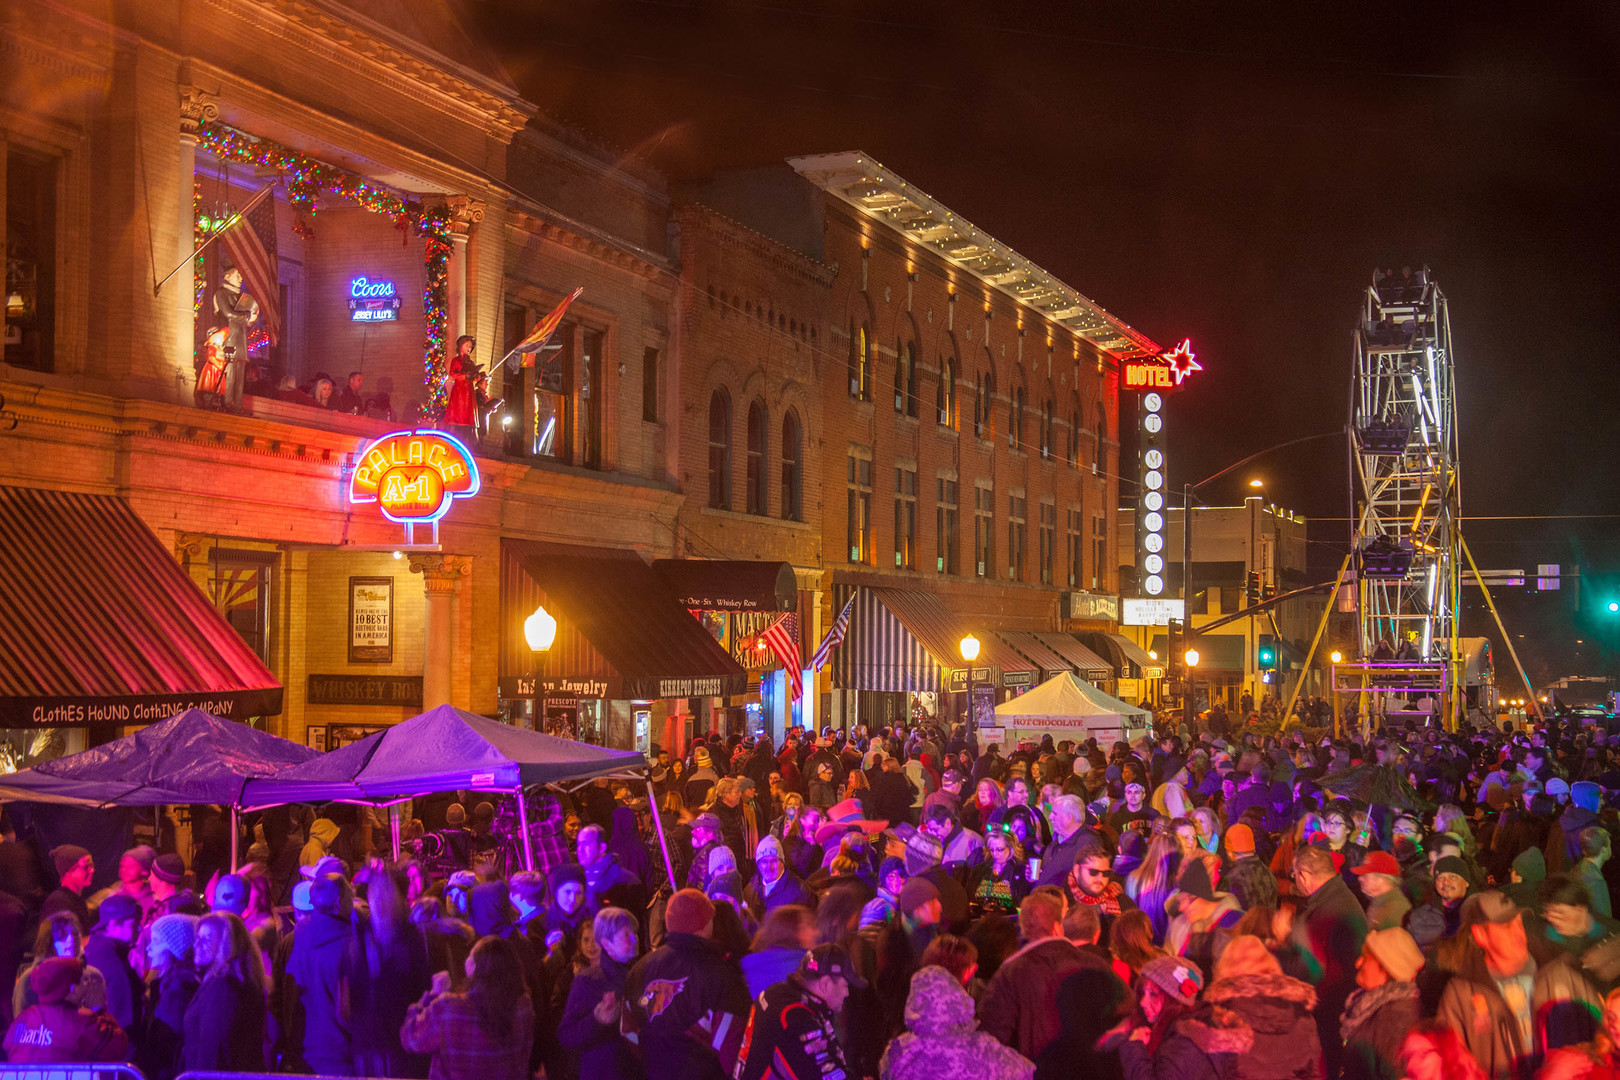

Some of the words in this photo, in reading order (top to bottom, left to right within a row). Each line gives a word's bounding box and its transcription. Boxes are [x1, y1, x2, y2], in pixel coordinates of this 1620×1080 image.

[351, 276, 395, 297] Coors
[1126, 364, 1173, 387] HOTEL
[355, 440, 466, 486] PALACE
[381, 475, 431, 502] A-1
[717, 598, 743, 609] Whiskey
[743, 599, 757, 607] Row
[355, 614, 365, 624] 10
[366, 614, 388, 624] BEST
[311, 681, 387, 700] WHISKEY
[559, 679, 608, 698] Jewelry
[693, 679, 721, 696] EXPRESS
[1012, 718, 1032, 727] HOT
[1032, 718, 1084, 728] CHOCOLATE
